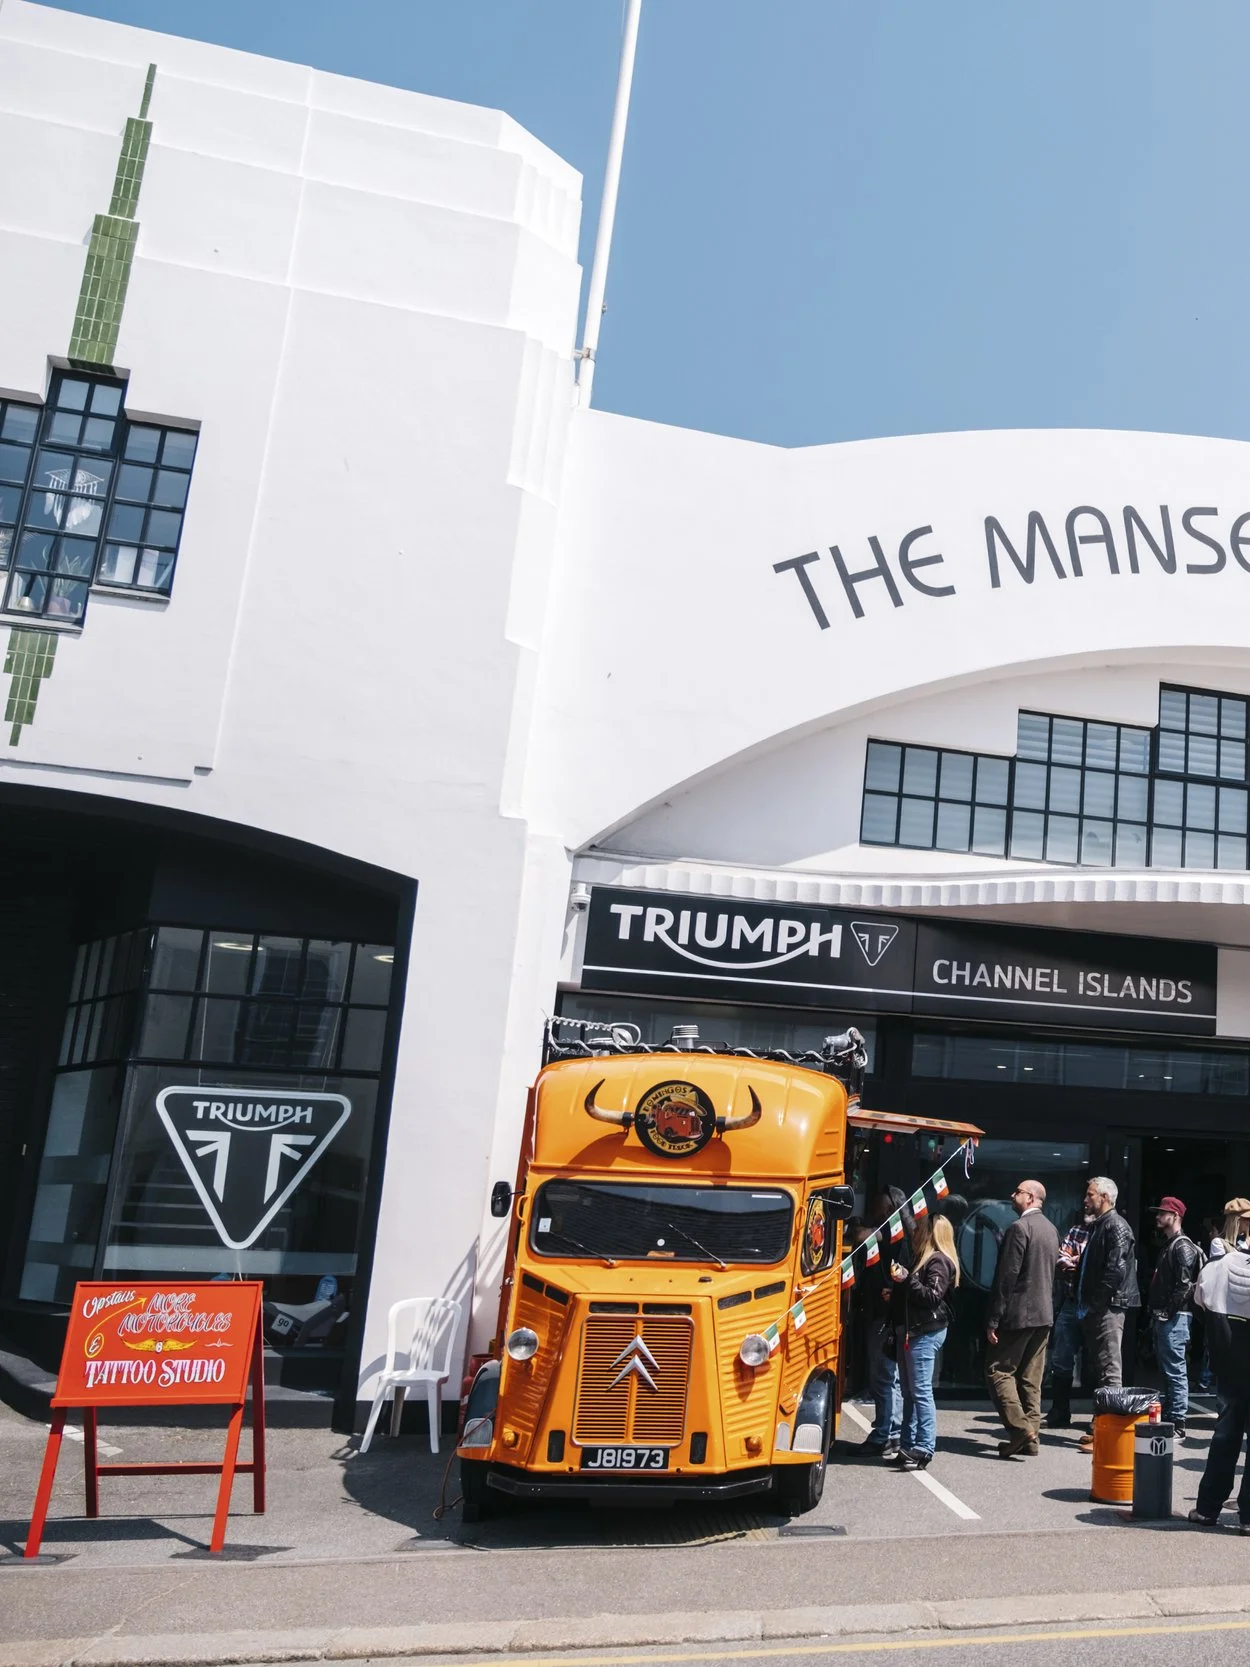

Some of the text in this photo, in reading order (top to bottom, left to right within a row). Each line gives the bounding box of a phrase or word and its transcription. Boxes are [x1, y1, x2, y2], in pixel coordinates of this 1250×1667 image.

[773, 525, 956, 631] THE
[610, 903, 842, 969] TRIUMPH
[932, 959, 1193, 1004] CHANNEL ISLANDS
[192, 1101, 313, 1131] TRIUMPH
[145, 1292, 197, 1313] MORE
[118, 1312, 233, 1337] MOTORCYCLES
[85, 1358, 225, 1388] TATTOO STUDIO
[588, 1449, 664, 1468] J81973
